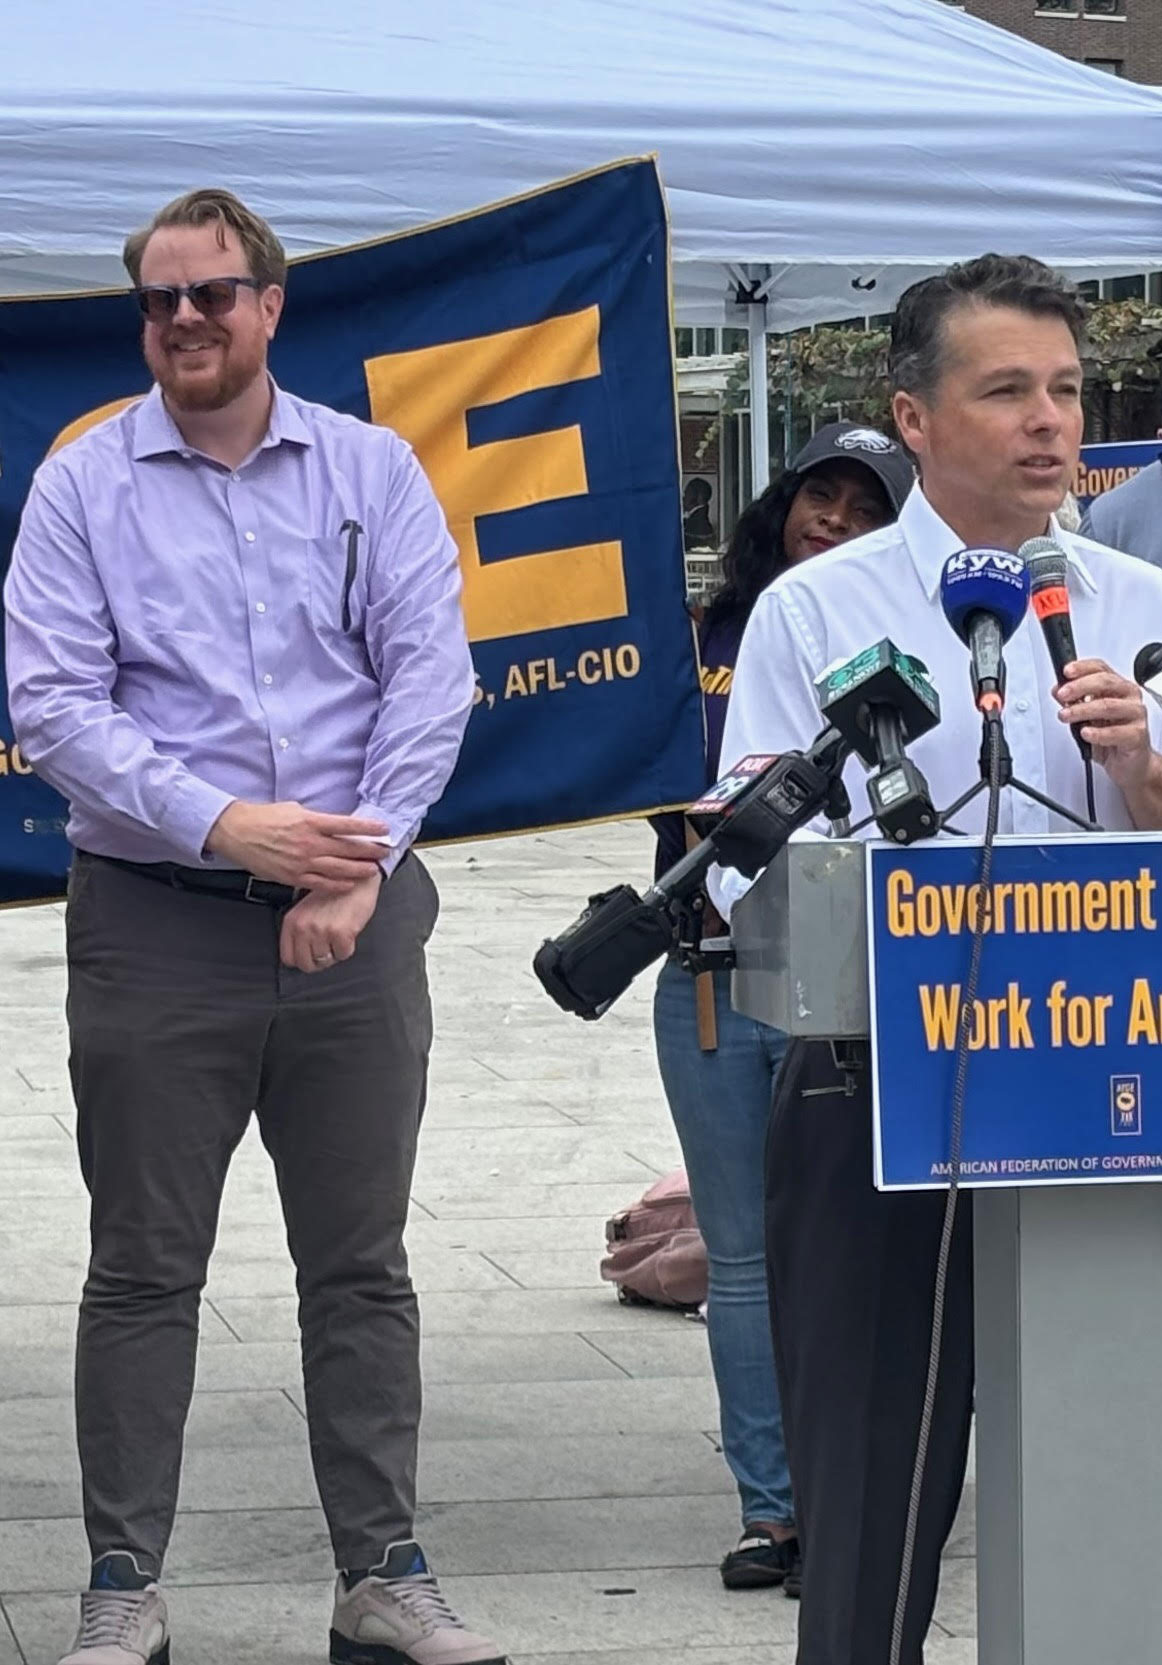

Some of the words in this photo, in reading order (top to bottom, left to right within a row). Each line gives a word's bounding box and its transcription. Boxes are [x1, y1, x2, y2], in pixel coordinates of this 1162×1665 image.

[504, 643, 641, 700] AFL-CIO
[887, 869, 1157, 938] Government
[918, 981, 1036, 1052] Work
[1045, 979, 1115, 1048] for
[930, 1160, 998, 1176] AMRICAN
[1000, 1157, 1078, 1173] FEDERATION
[1081, 1157, 1099, 1170] OF
